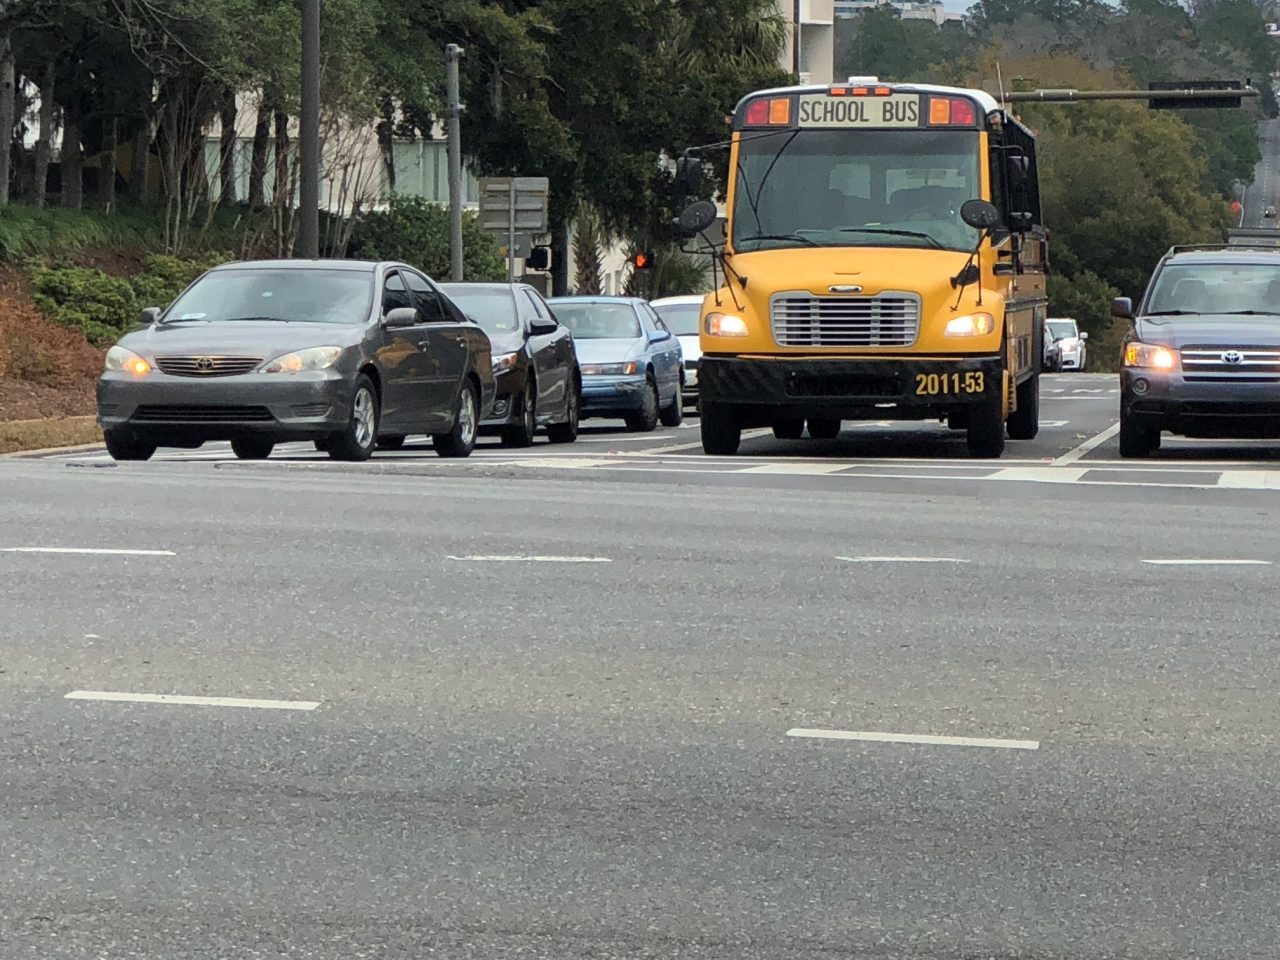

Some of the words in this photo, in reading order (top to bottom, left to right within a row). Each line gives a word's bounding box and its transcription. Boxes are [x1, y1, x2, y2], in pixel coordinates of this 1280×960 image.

[800, 100, 870, 123] SCHOOL
[882, 100, 918, 123] BUS
[915, 371, 985, 395] 2011-53
